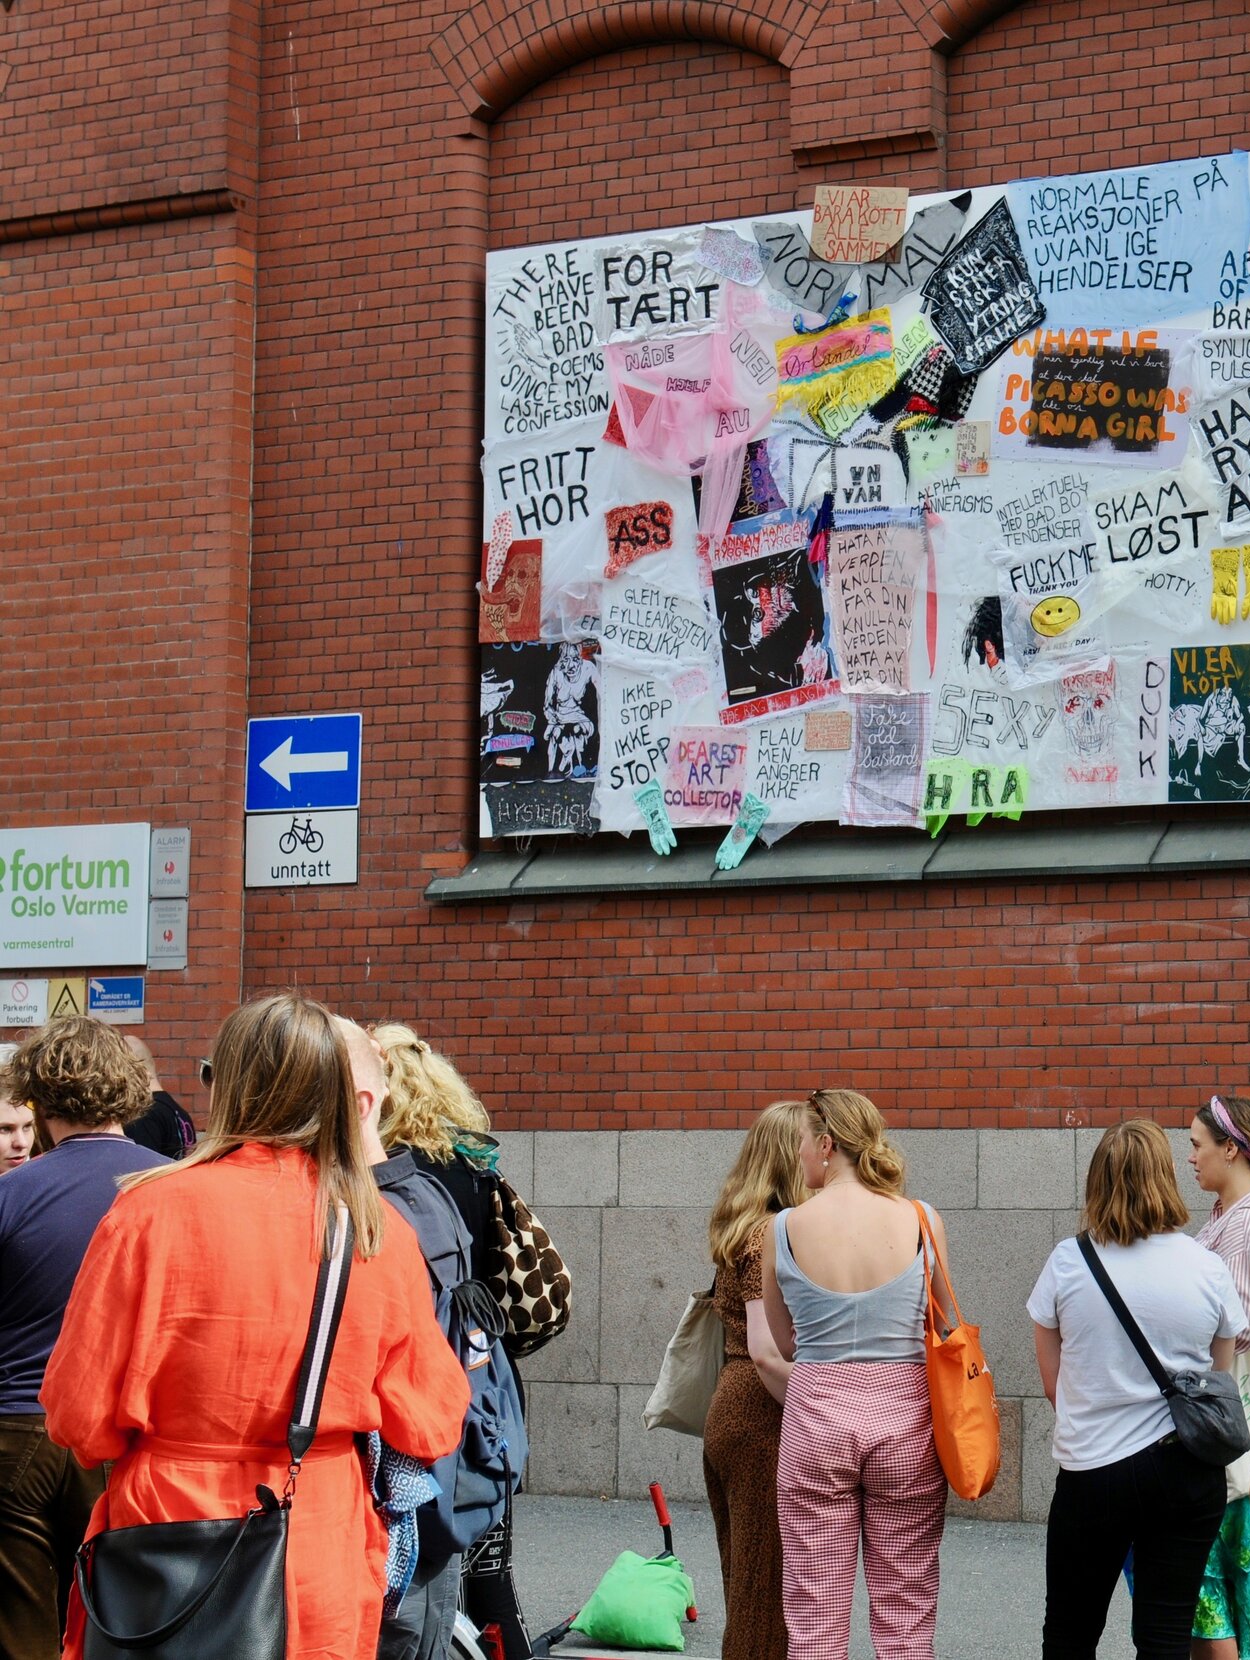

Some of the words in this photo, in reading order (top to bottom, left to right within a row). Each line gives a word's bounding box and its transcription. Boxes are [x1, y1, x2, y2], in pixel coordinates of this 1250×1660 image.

[828, 190, 844, 206] VI
[1030, 177, 1150, 216] NORMALE
[1193, 159, 1228, 200] PÅ
[814, 204, 853, 224] BARA
[858, 206, 907, 226] KÖTT
[1027, 189, 1182, 239] REAKSJONER
[824, 221, 869, 241] ALLE
[825, 240, 897, 262] SAMMEN
[1034, 228, 1157, 267] UVANLIGE
[493, 249, 580, 319] THERE
[602, 250, 674, 291] FOR
[1038, 260, 1193, 295] HENDELSER
[538, 272, 594, 308] HAVE
[1220, 279, 1248, 300] OF
[534, 298, 590, 331] BEEN
[606, 284, 720, 329] TÆRT
[967, 281, 1031, 335] YTRING
[552, 321, 594, 356] BAD
[1012, 327, 1113, 358] WHAT
[1122, 329, 1159, 357] IF
[550, 352, 605, 383] POEMS
[625, 344, 674, 371] NÅDE
[730, 332, 777, 385] NEI
[500, 364, 557, 404] SINCE
[565, 373, 595, 398] MY
[1005, 374, 1121, 408] PICASSO
[1127, 386, 1192, 414] WAS
[500, 397, 542, 418] LAST
[503, 391, 609, 434] CONFESSION
[715, 408, 749, 438] AU
[1106, 412, 1176, 442] GIRL
[498, 447, 595, 501] FRITT
[918, 476, 960, 501] ALPHA
[996, 472, 1089, 521] INTELLEKTUELL
[516, 484, 590, 536] HOR
[910, 495, 993, 517] MANNERISMS
[1001, 516, 1022, 533] MED
[1026, 504, 1055, 529] BAD
[1060, 482, 1089, 515] BOY
[1095, 480, 1188, 530] SKAM
[609, 507, 671, 553] ASS
[838, 533, 869, 554] HATA
[1004, 519, 1082, 547] TENDENSER
[1107, 510, 1209, 563] LØST
[838, 550, 906, 574] VERDEN
[1009, 552, 1066, 592] FUCK
[840, 568, 899, 596] KNULLA
[1060, 579, 1079, 589] YOU
[1144, 573, 1196, 597] HOTTY
[844, 587, 876, 614] FAR
[882, 586, 907, 614] DIN
[609, 605, 712, 650] FYLLEANGSTEN
[842, 611, 896, 636] KNULLA
[603, 624, 686, 659] ØYEBLIKK
[844, 630, 897, 651] VERDEN
[846, 650, 881, 669] HATA
[884, 650, 904, 665] AV
[1173, 649, 1197, 674] VI
[848, 670, 875, 686] FAR
[879, 668, 903, 686] DIN
[622, 681, 656, 704] IKKE
[620, 699, 672, 725] STOPP
[864, 703, 913, 726] Fake
[933, 683, 1056, 755] SEXY
[614, 724, 652, 758] IKKE
[760, 728, 803, 746] FLAU
[868, 727, 903, 745] old
[610, 736, 671, 790] STOPP
[678, 740, 747, 767] DEAREST
[758, 748, 791, 763] MEN
[687, 764, 731, 786] ART
[757, 763, 820, 782] ANGRER
[664, 789, 742, 816] COLLECTOR
[760, 781, 800, 800] IKKE
[497, 801, 594, 830] HYSTERISK
[156, 836, 185, 846] ALARM
[10, 849, 130, 892] fortum
[271, 860, 331, 879] unntatt
[11, 895, 56, 918] Oslo
[62, 895, 128, 917] Varme
[3, 937, 74, 950] varmesentral
[3, 1004, 38, 1013] Parkering
[6, 1015, 33, 1023] forbudt
